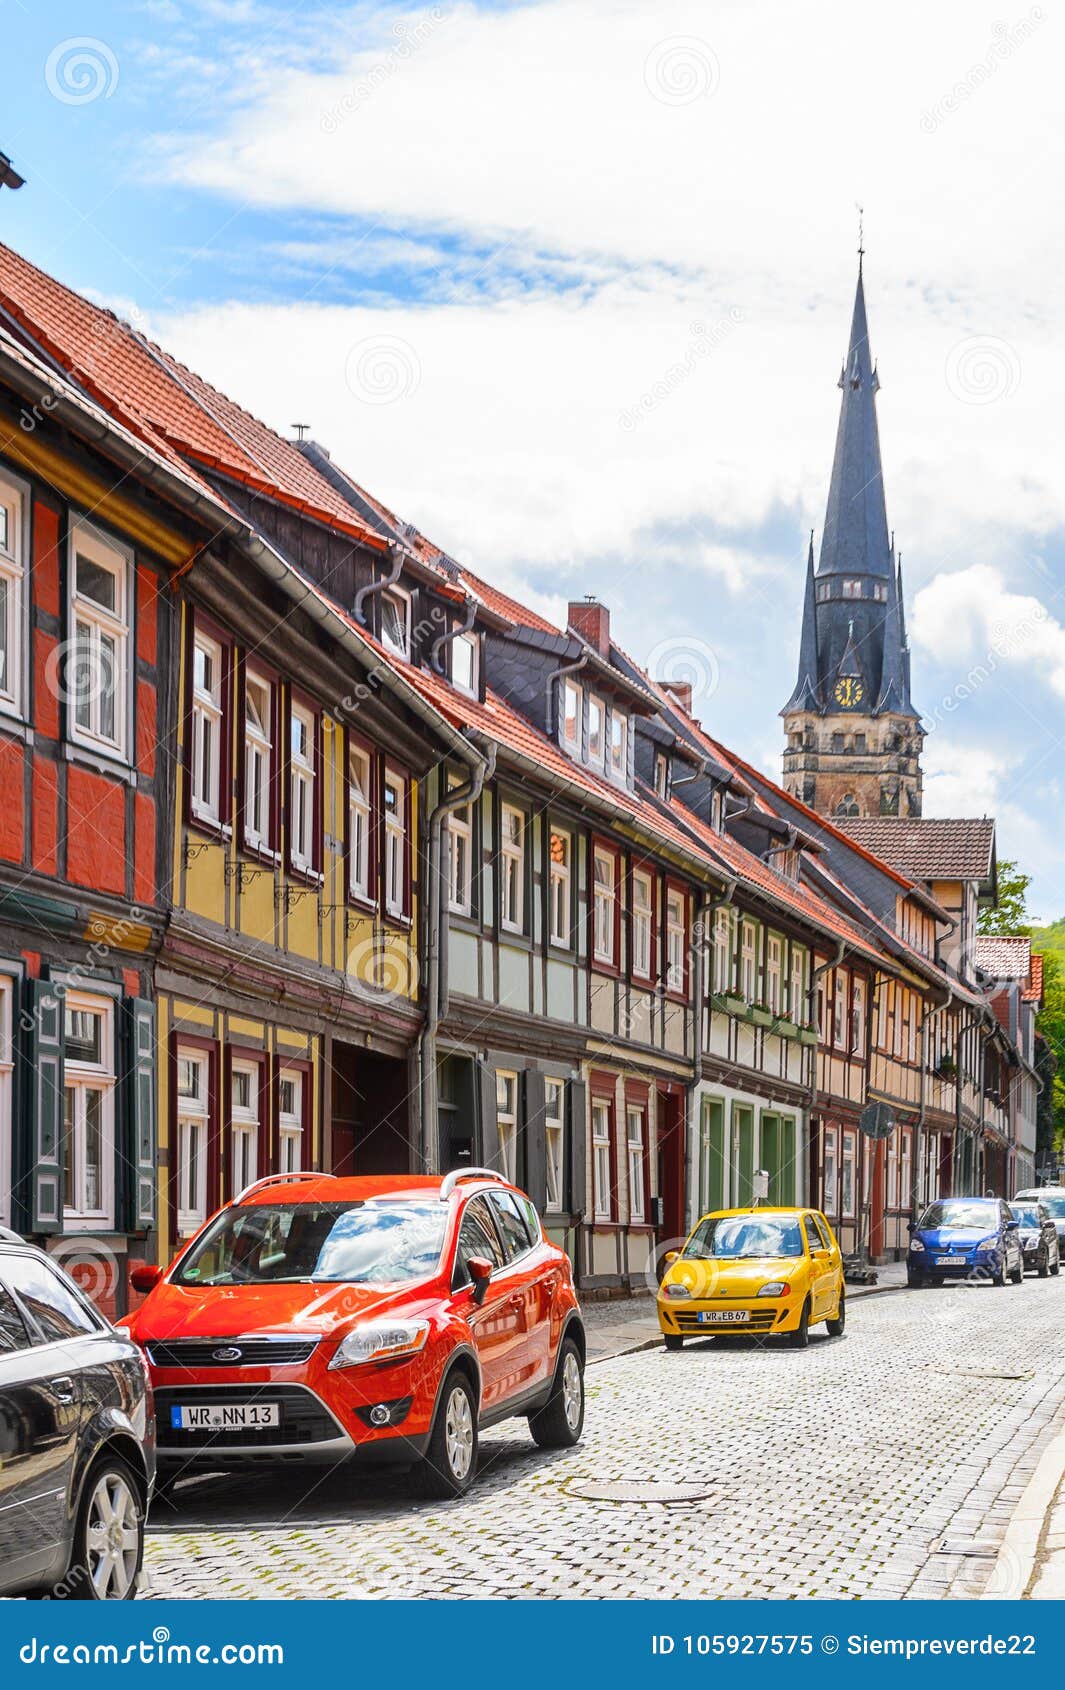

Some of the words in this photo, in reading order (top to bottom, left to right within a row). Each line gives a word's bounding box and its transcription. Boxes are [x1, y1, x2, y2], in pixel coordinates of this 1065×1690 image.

[188, 1408, 211, 1425] WR
[223, 1407, 246, 1425] NN
[250, 1407, 272, 1424] 13
